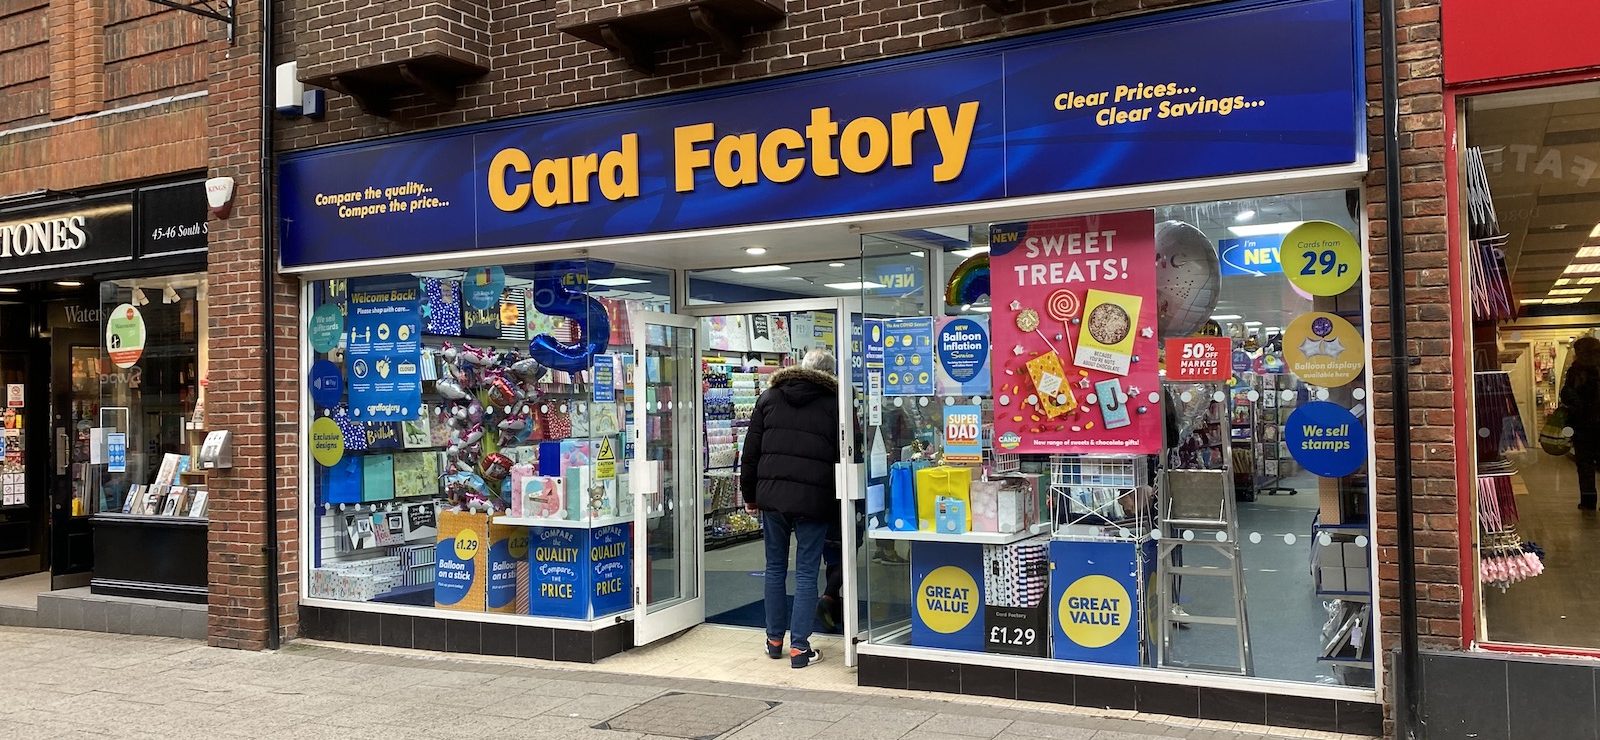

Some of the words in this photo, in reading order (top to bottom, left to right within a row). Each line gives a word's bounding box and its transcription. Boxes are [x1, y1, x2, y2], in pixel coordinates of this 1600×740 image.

[1054, 90, 1108, 111] Clear
[1114, 80, 1197, 103] Prices...
[1096, 105, 1152, 127] Clear
[1157, 94, 1266, 119] Savings...
[488, 132, 640, 212] Card
[674, 101, 980, 193] Factory
[208, 184, 226, 192] KINGS
[315, 190, 362, 207] Compare
[364, 186, 382, 200] the
[384, 182, 433, 204] quality...
[338, 202, 387, 219] Compare
[389, 199, 407, 212] the
[410, 196, 450, 214] price...
[0, 216, 87, 258] TONES
[152, 226, 176, 240] 45-46
[178, 224, 200, 238] South
[992, 232, 1018, 243] NEW
[1026, 230, 1116, 258] SWEET
[1297, 241, 1321, 249] Cards
[1300, 250, 1348, 277] 29p
[1014, 258, 1128, 286] TREATS!
[352, 292, 390, 304] Welcome
[390, 288, 416, 301] Back!
[372, 306, 383, 314] shop
[326, 314, 336, 322] sell
[464, 309, 500, 330] Birthday
[313, 323, 339, 334] giftcards
[943, 332, 981, 341] Balloon
[943, 341, 982, 351] Inflation
[951, 351, 974, 359] Service
[1094, 350, 1112, 359] BECAUSE
[1096, 362, 1120, 372] CHOCOLATE
[1295, 362, 1325, 370] Balloon
[1326, 361, 1361, 370] displays
[1106, 387, 1118, 411] J
[367, 403, 400, 414] cardfactory
[948, 414, 979, 424] SUPER
[314, 433, 340, 441] Exclusive
[949, 424, 980, 439] DAD
[1302, 425, 1323, 437] We
[1326, 424, 1348, 436] sell
[316, 442, 337, 451] designs
[1301, 439, 1350, 452] stamps
[540, 529, 574, 542] COMPARE
[595, 526, 622, 539] COMPARE
[456, 540, 478, 550] £1.29
[591, 542, 626, 562] QUALITY
[536, 547, 578, 562] QUALITY
[439, 559, 465, 570] Balloon
[454, 571, 471, 580] stick
[542, 583, 572, 598] PRICE
[596, 578, 622, 596] PRICE
[926, 585, 969, 600] GREAT
[926, 598, 969, 614] VALUE
[1068, 596, 1120, 612] GREAT
[1070, 611, 1120, 626] VALUE
[990, 626, 1036, 646] £1.29
